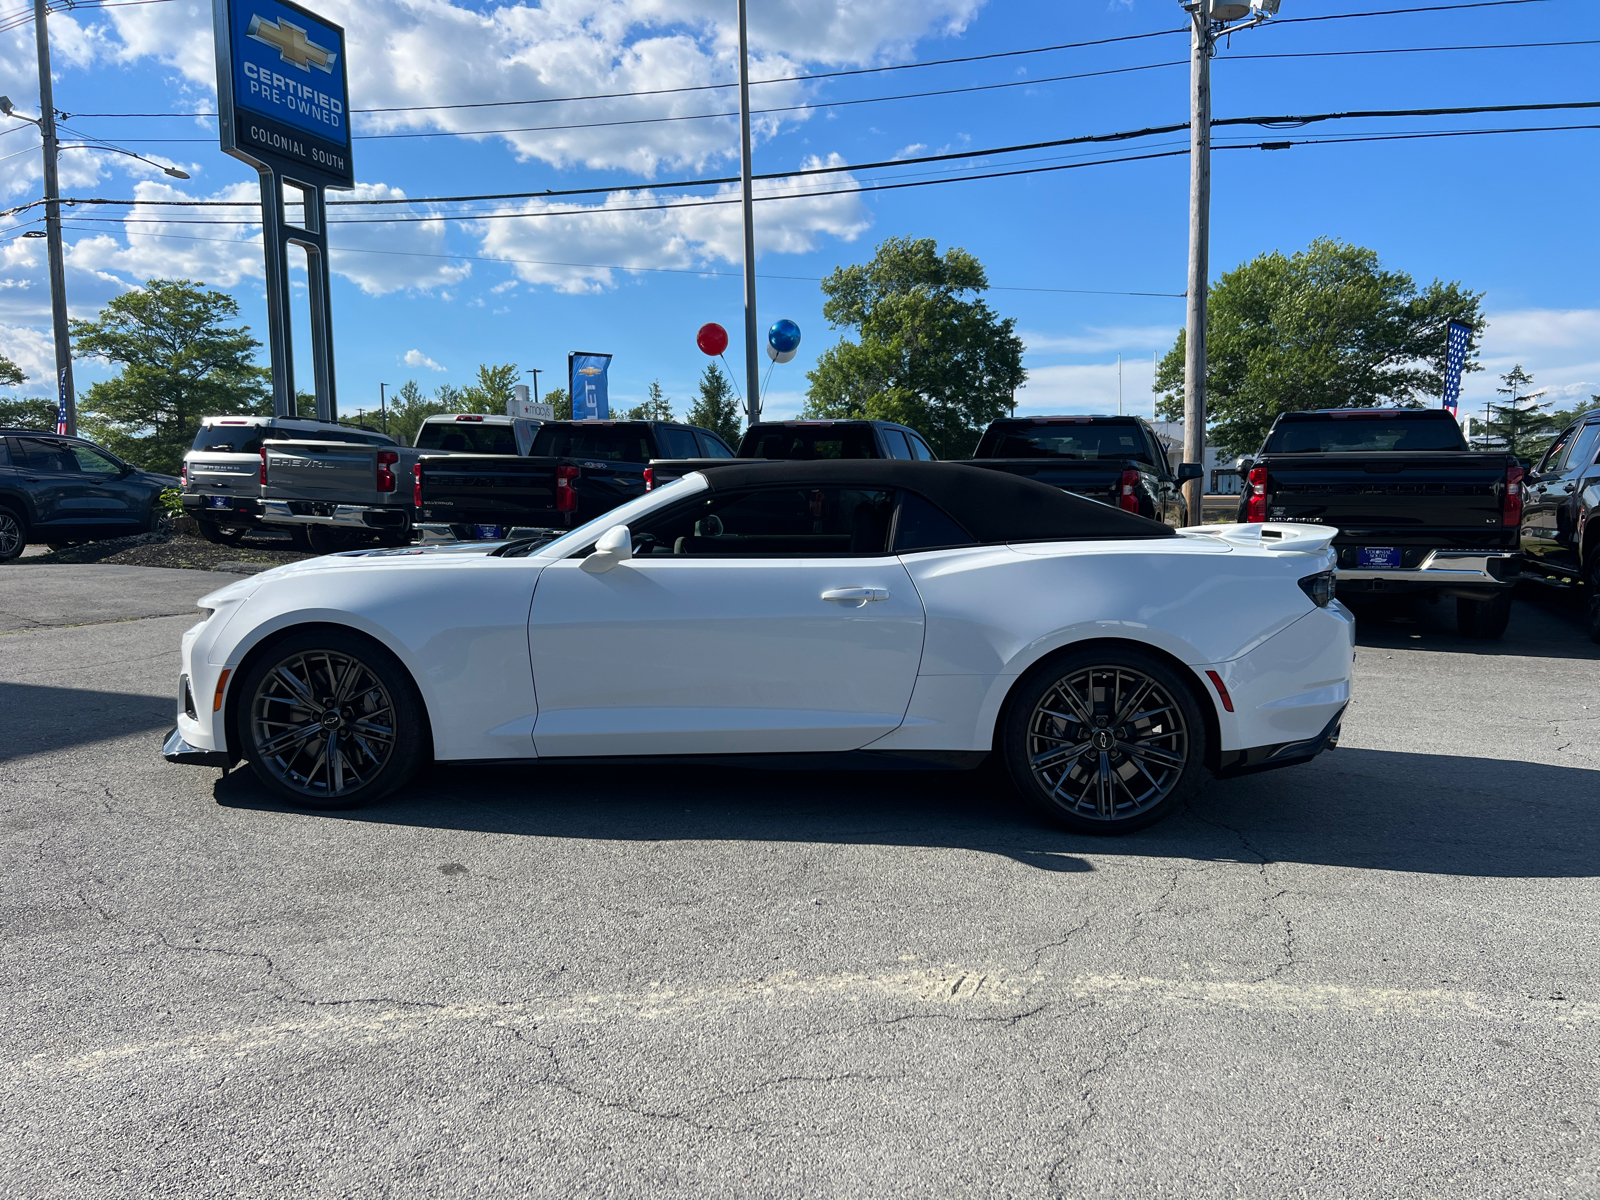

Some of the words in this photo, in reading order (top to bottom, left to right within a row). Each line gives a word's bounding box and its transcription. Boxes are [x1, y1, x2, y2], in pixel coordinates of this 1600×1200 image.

[244, 61, 342, 114] CERTIFIED
[251, 80, 339, 127] PRE-OWNED
[251, 126, 306, 157] COLONIAL
[312, 148, 344, 170] SOUTH
